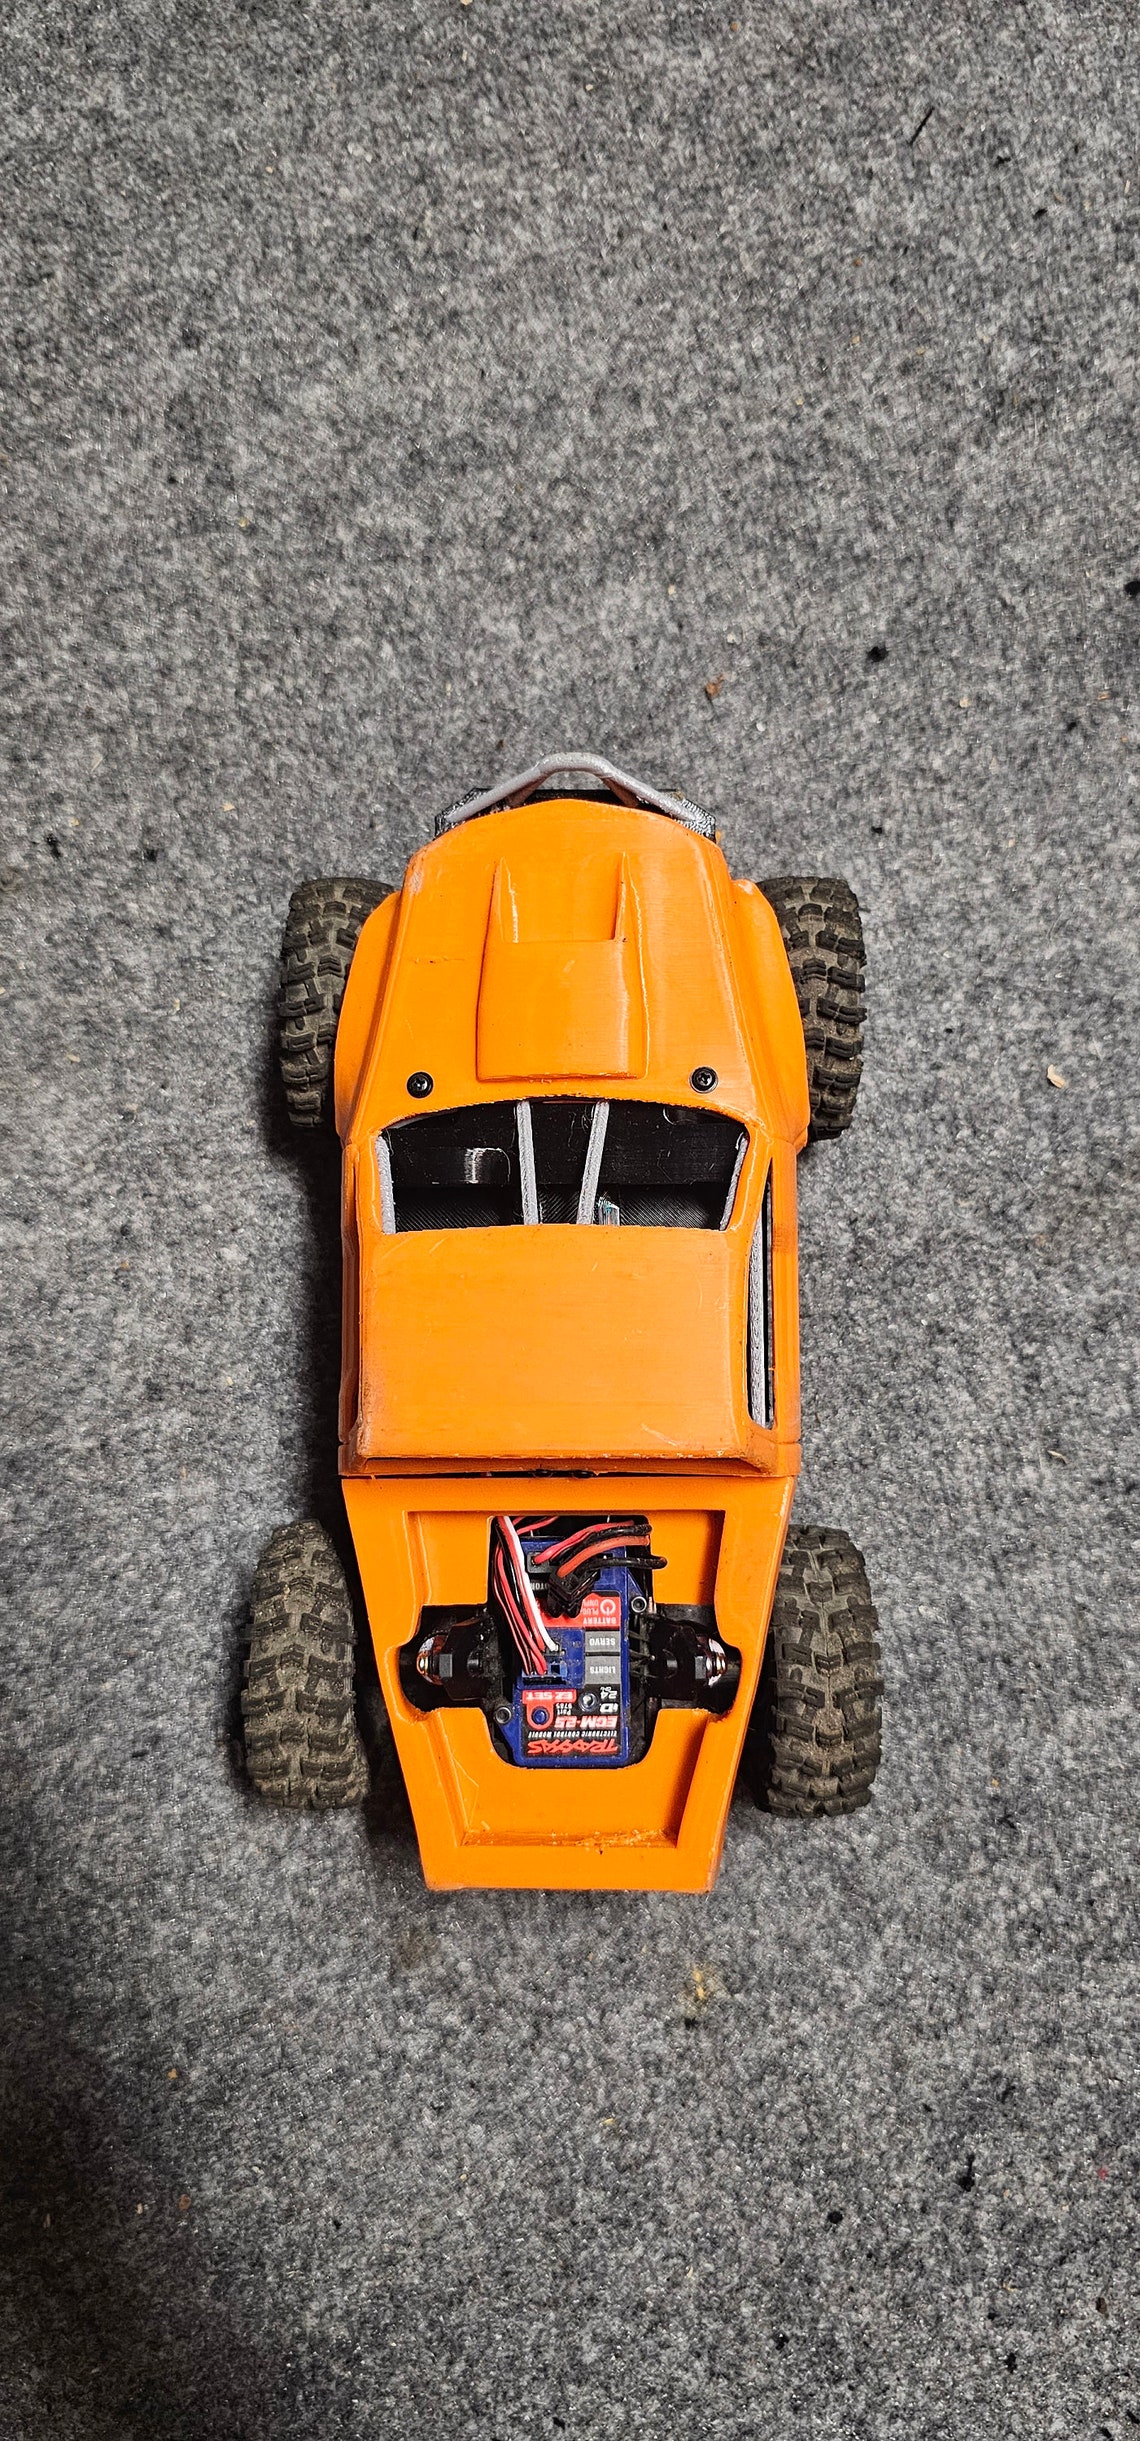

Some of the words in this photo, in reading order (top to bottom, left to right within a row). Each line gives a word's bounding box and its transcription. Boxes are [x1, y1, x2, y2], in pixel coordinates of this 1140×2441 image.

[589, 1638, 616, 1646] SERVO
[590, 1666, 616, 1674] LIGHTS
[526, 1691, 553, 1700] SET
[555, 1691, 573, 1700] EZ
[553, 1730, 580, 1738] CONTROL
[581, 1730, 618, 1738] ELECTRONIC
[527, 1738, 618, 1754] TRAXXAS
